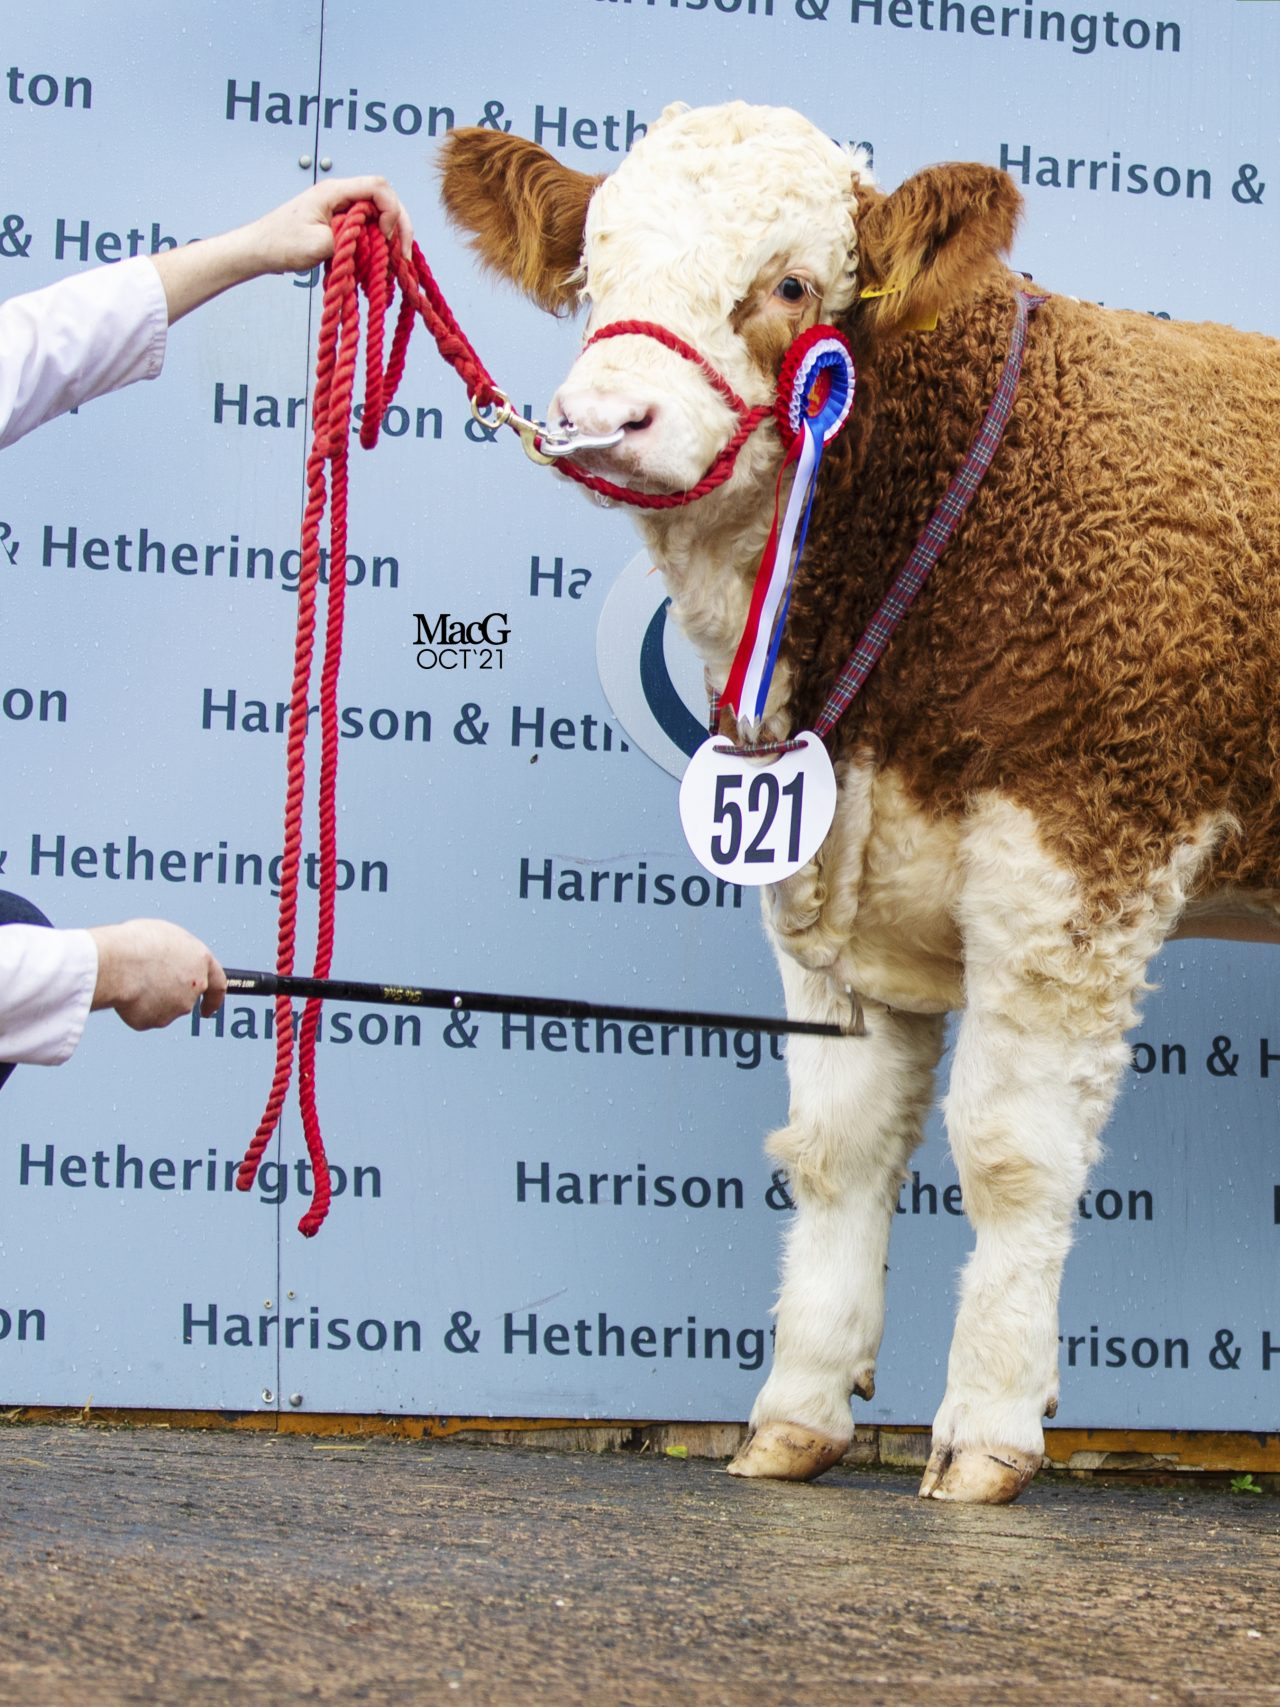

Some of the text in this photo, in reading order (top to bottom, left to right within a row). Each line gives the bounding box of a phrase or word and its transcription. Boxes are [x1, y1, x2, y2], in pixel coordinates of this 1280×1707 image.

[850, 0, 1181, 55] Hetherington
[225, 79, 455, 137] Harrison
[477, 100, 513, 133] &
[999, 143, 1211, 200] Harrison
[1231, 163, 1266, 205] &
[0, 214, 33, 258] &
[213, 382, 443, 440] Haron
[42, 525, 399, 592] Hetherington
[202, 688, 432, 743] Harrson
[453, 702, 490, 745] &
[710, 771, 805, 866] 521
[519, 857, 743, 909] Harrison
[442, 1008, 479, 1048] &
[1206, 1035, 1240, 1077] &
[516, 1161, 744, 1209] Harrison
[182, 1302, 776, 1371] Harrison & Hethering
[1208, 1328, 1242, 1371] &
